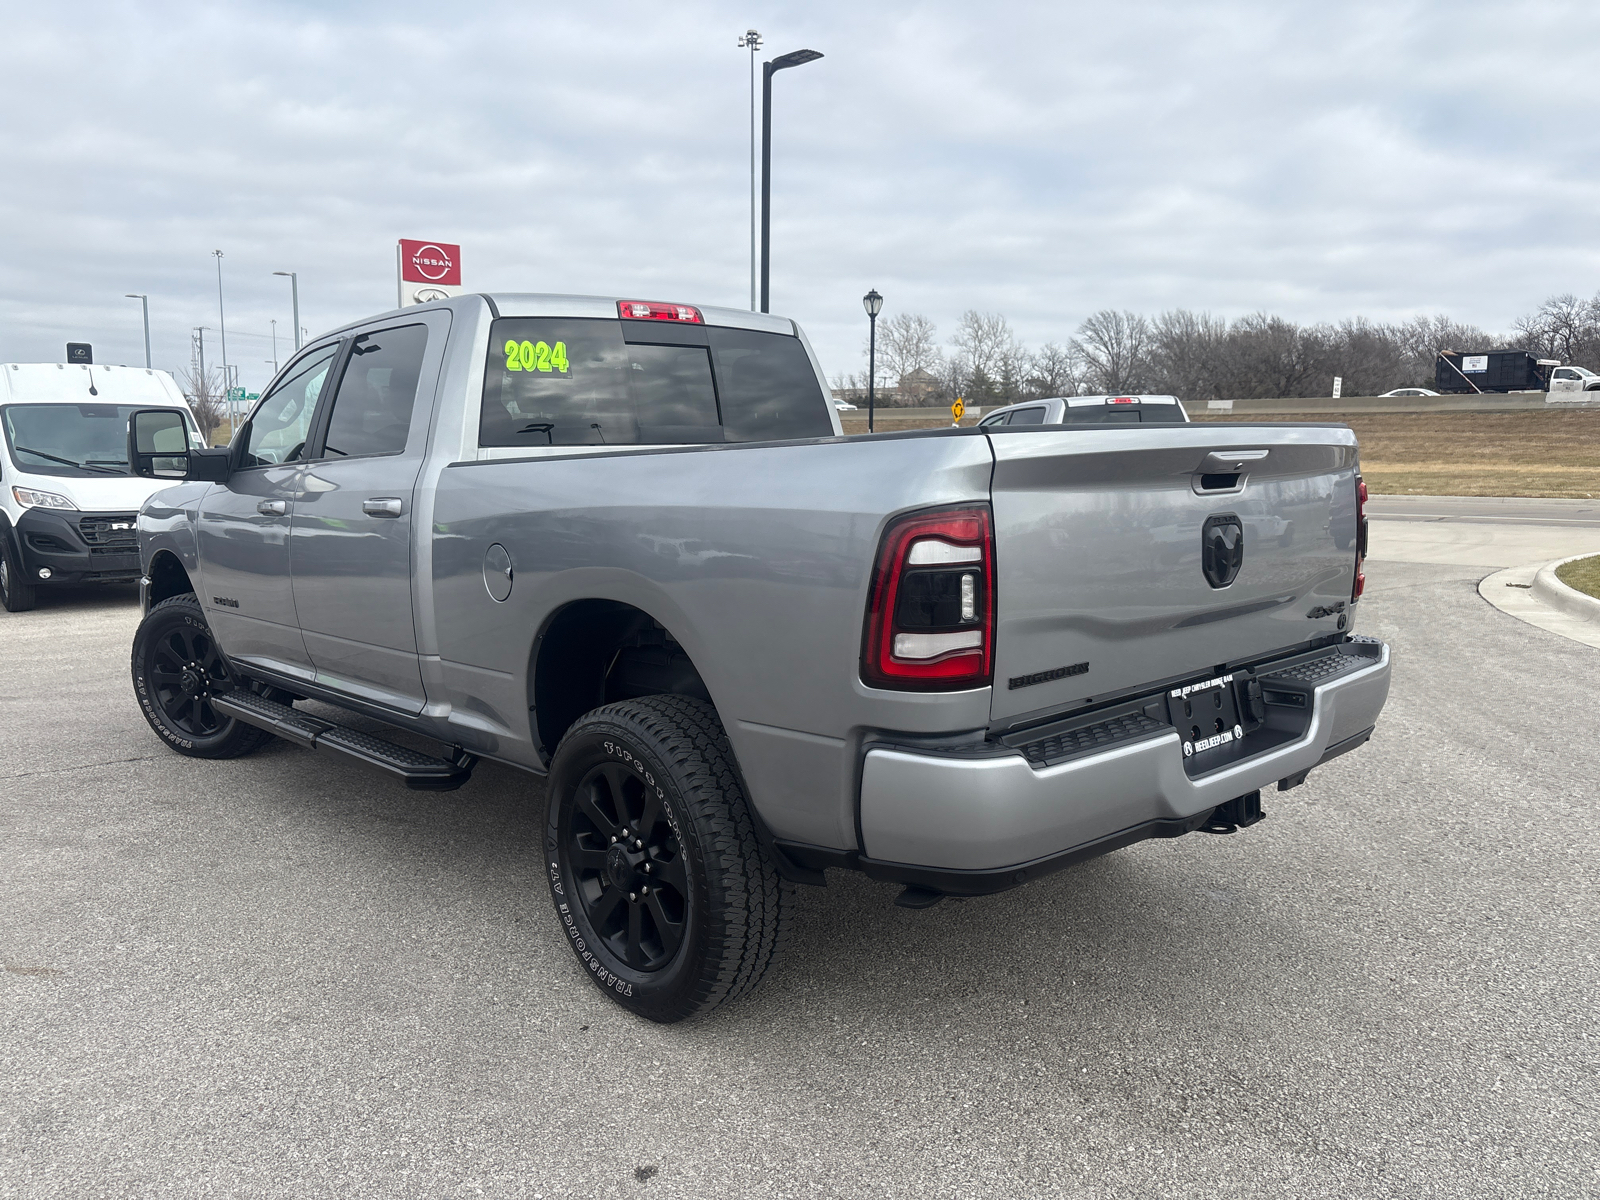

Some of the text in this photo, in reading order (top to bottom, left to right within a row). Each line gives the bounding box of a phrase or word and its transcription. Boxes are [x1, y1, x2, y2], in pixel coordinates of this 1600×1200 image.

[412, 257, 452, 267] NISSAN
[504, 340, 569, 372] 2024
[1182, 686, 1192, 695] JEEP
[1191, 681, 1210, 692] CHRYSLER
[1223, 674, 1233, 683] RAM
[559, 902, 633, 997] TRANSFORCE
